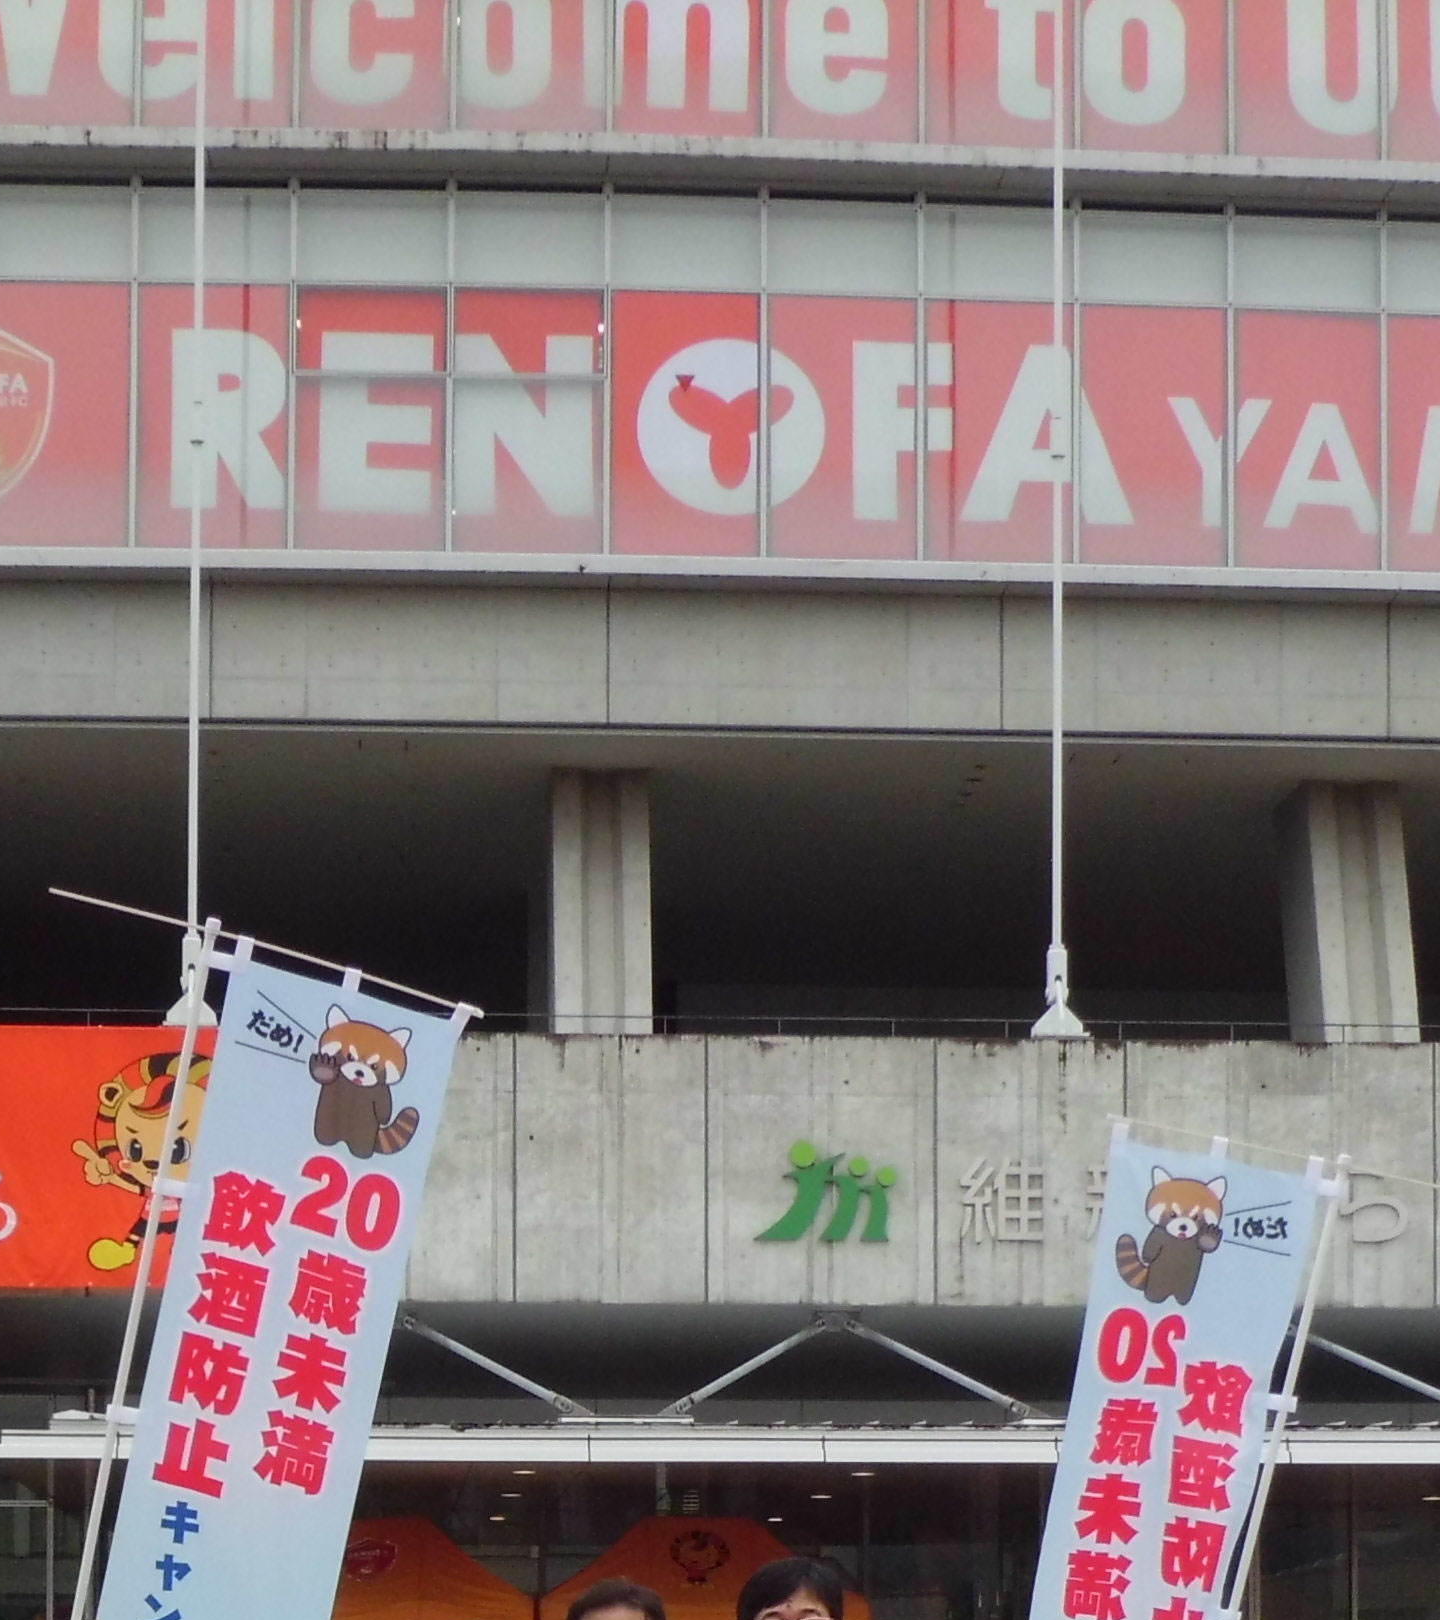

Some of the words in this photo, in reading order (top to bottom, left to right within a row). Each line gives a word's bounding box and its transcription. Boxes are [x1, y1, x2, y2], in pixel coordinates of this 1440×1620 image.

[985, 0, 1187, 125] to
[171, 328, 1135, 527] RENOFA
[245, 1008, 304, 1054] だめ!
[253, 1155, 402, 1497] 20歳未満
